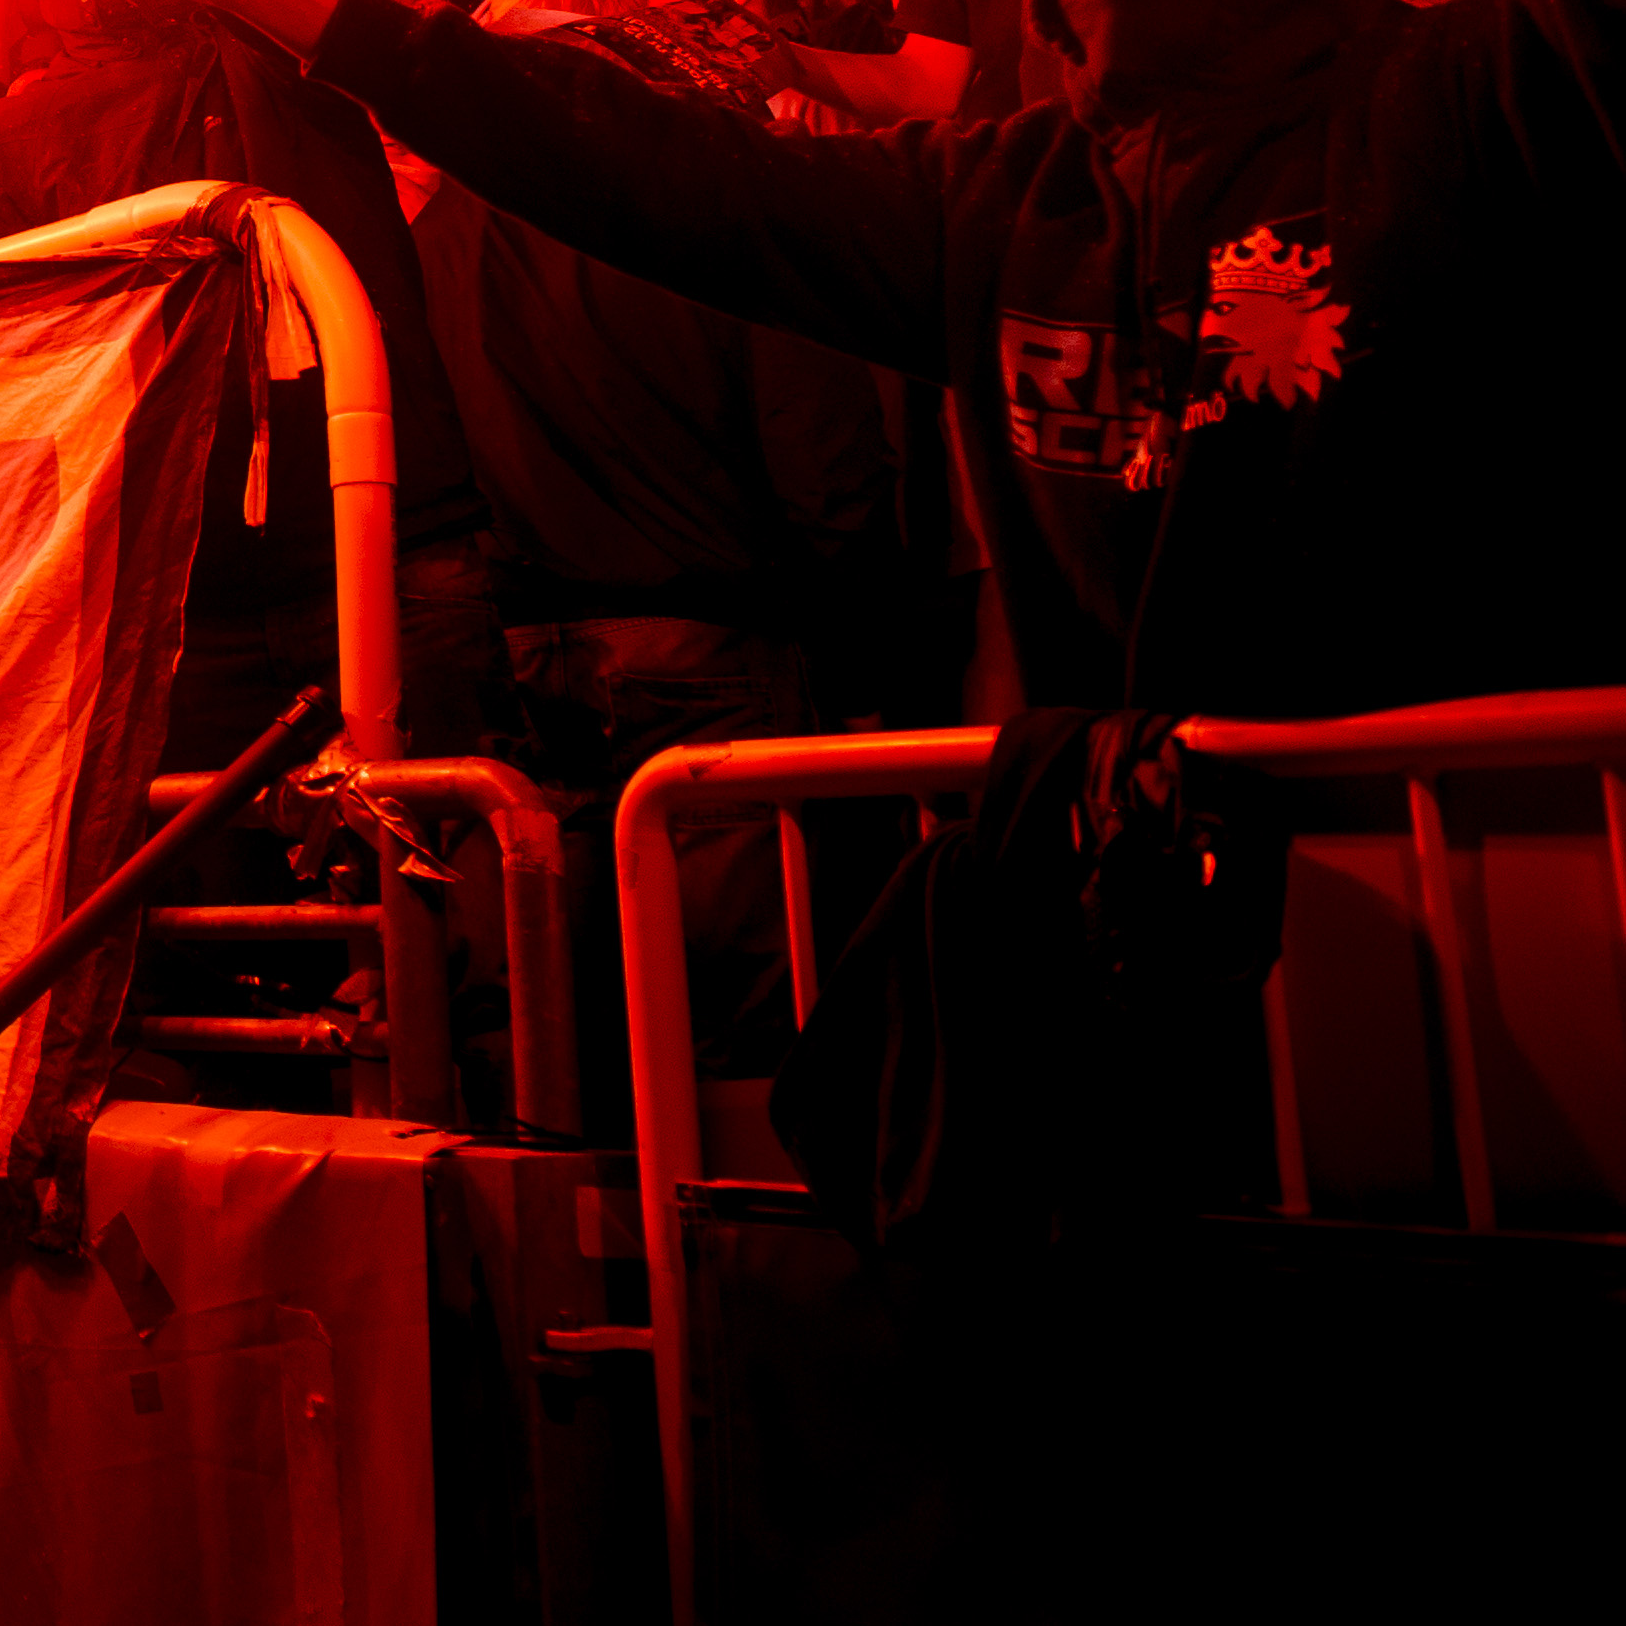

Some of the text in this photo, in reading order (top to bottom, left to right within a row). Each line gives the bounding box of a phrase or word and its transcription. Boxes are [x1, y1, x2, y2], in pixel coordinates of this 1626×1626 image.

[624, 24, 708, 89] Tack nr 12
